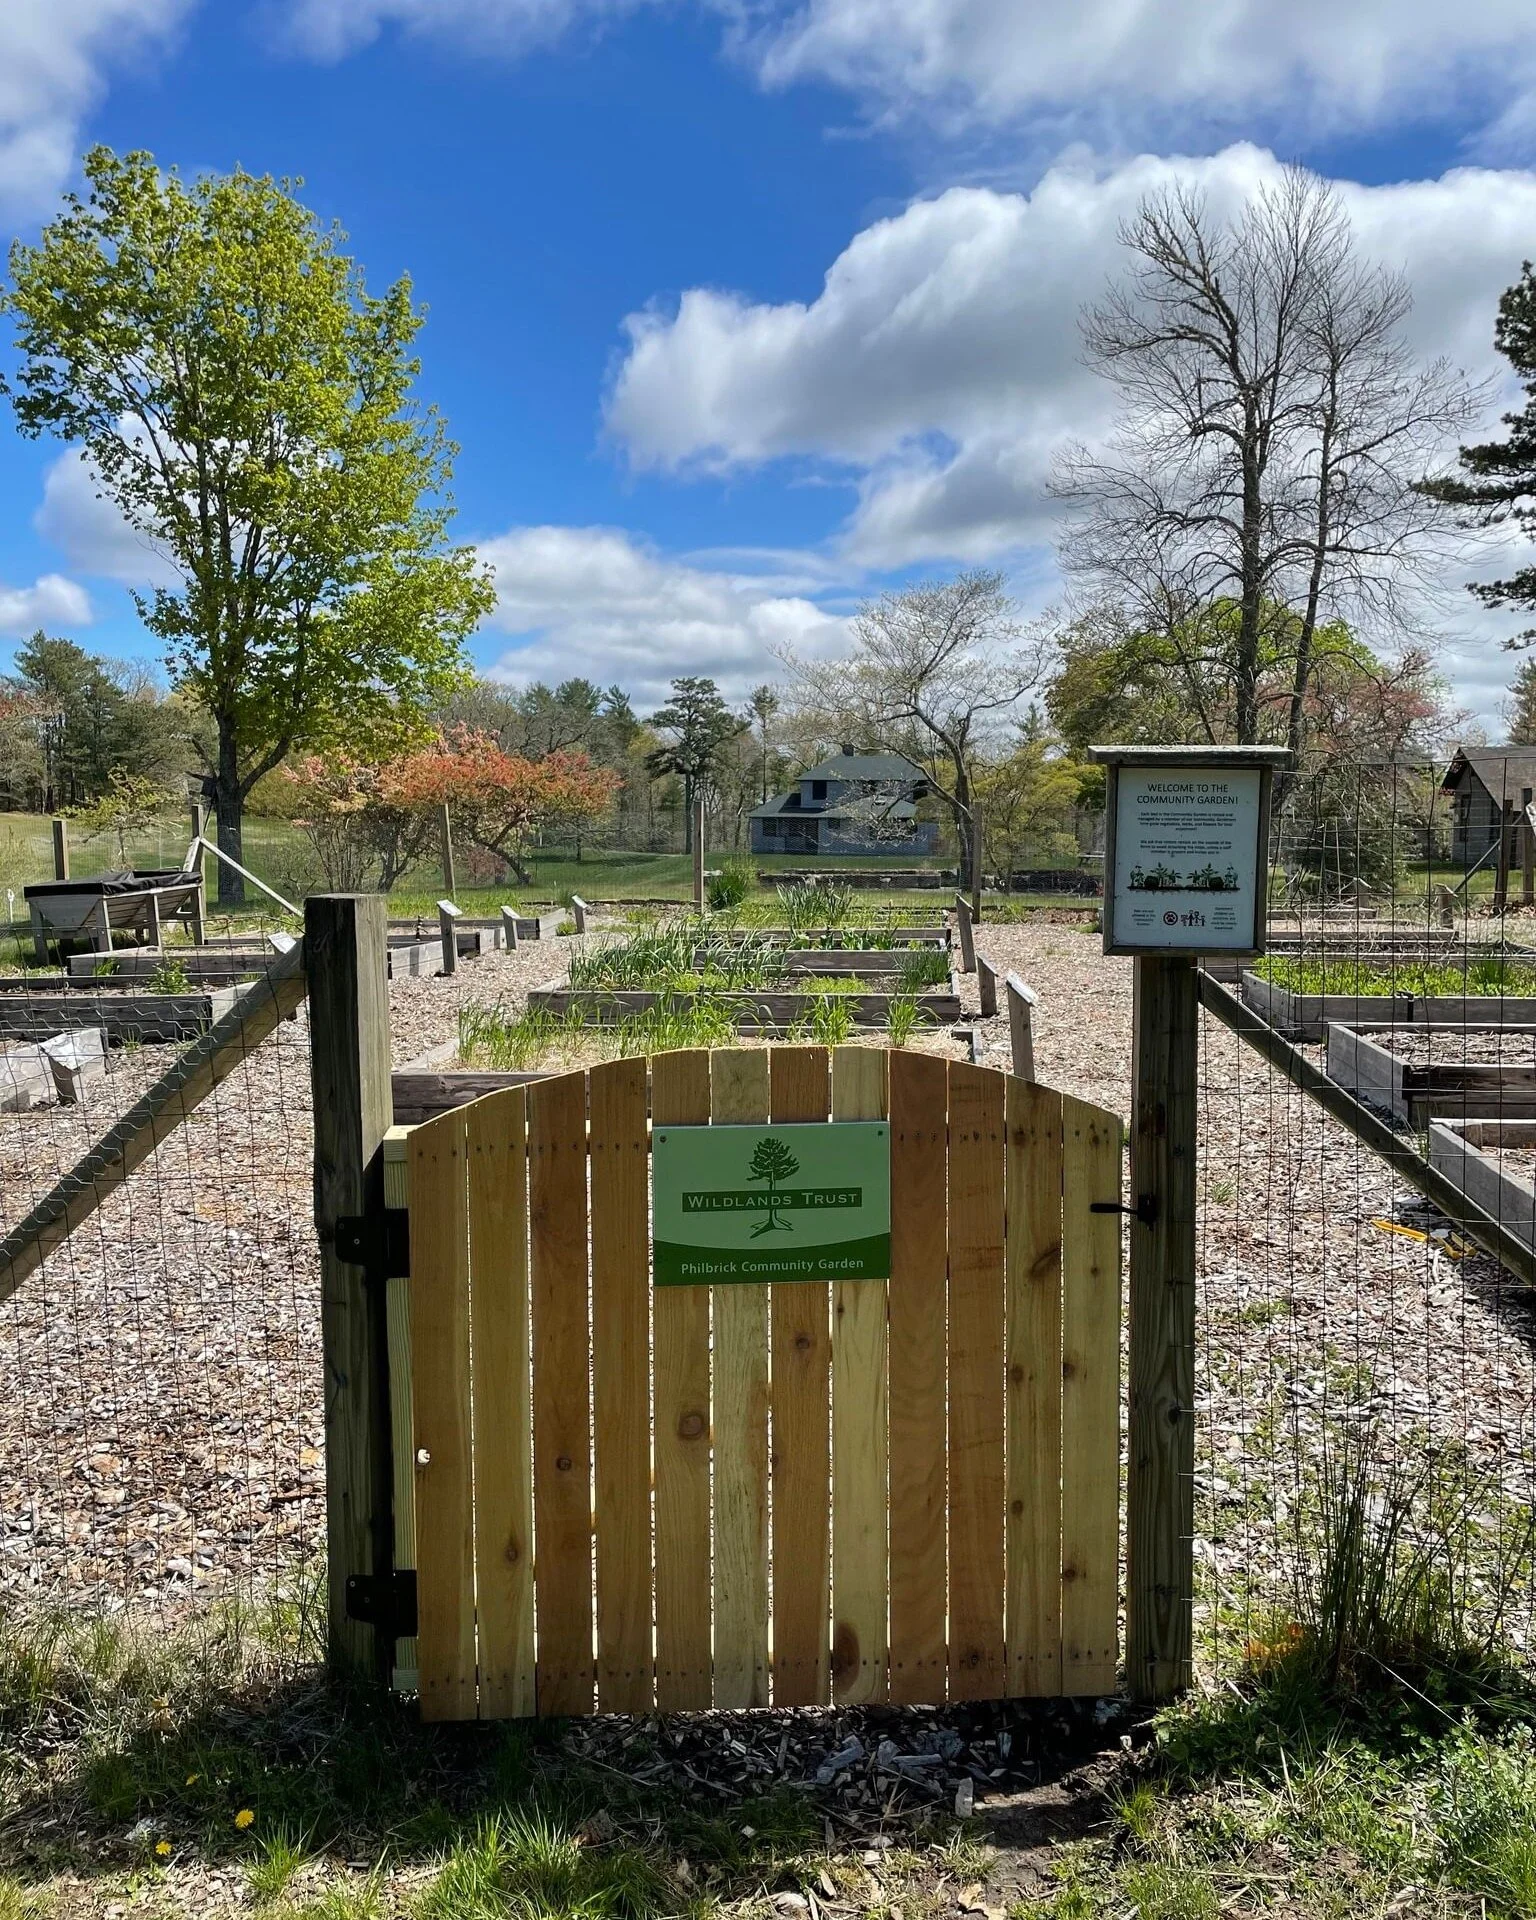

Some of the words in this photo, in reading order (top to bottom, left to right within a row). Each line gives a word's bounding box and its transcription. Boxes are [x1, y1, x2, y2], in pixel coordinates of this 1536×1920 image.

[1147, 783, 1194, 793] WELCOME
[1196, 783, 1209, 793] TO
[1211, 783, 1229, 793] THE
[1136, 795, 1196, 805] COMMUNITY
[1197, 795, 1238, 805] GARDEN!
[687, 1194, 792, 1209] WILDLANDS
[801, 1192, 857, 1206] TRUST
[681, 1261, 737, 1274] Philbrick
[741, 1259, 814, 1273] Community
[818, 1257, 864, 1270] Garden
